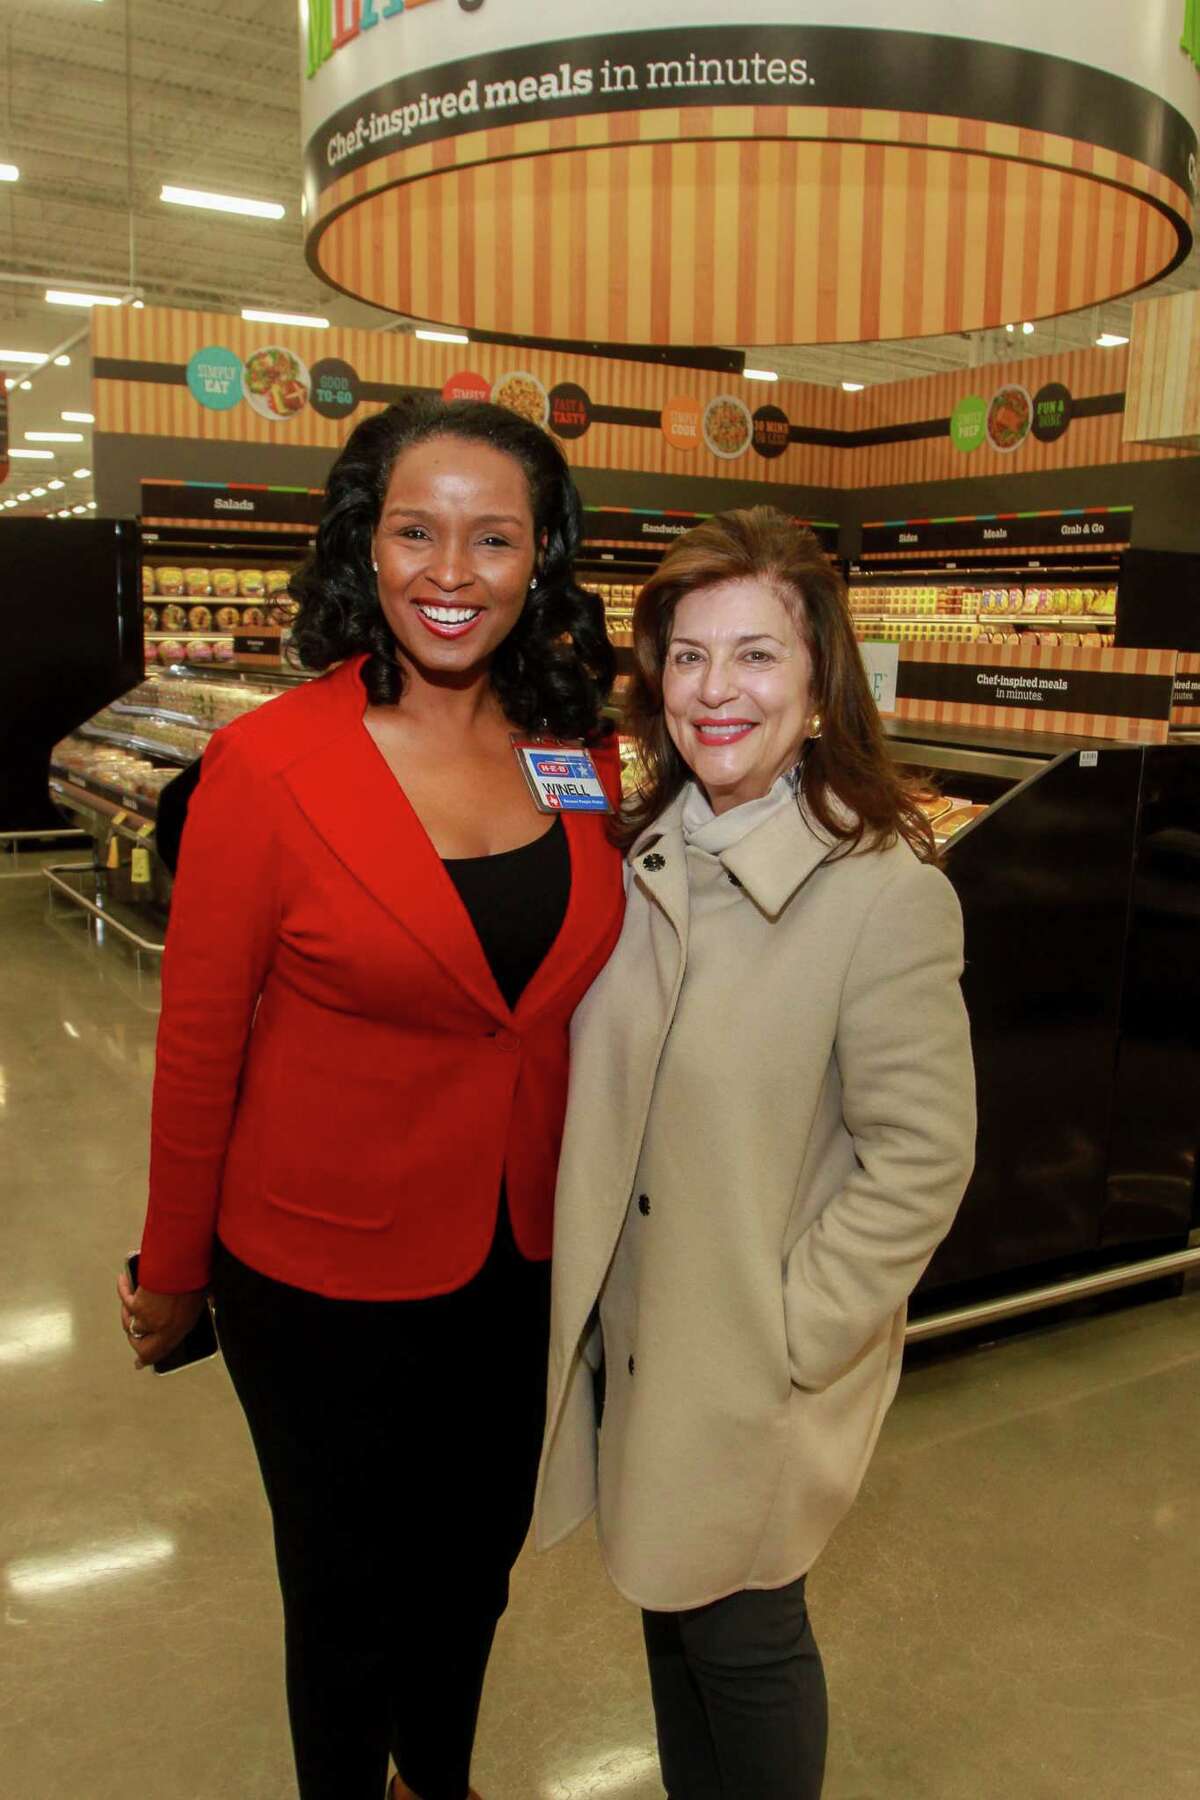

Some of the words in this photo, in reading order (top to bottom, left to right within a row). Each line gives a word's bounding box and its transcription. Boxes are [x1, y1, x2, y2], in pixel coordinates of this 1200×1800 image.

[326, 79, 480, 167] Chef-inspired
[484, 63, 594, 109] meals
[600, 60, 637, 92] in
[646, 53, 816, 90] minutes.
[198, 364, 237, 380] SIMPLY
[204, 379, 231, 394] EAT
[319, 375, 349, 390] GOOD
[317, 388, 353, 404] TO-GO
[452, 387, 486, 400] SIMPLY
[554, 397, 577, 412] FAST
[1037, 400, 1057, 415] FUN
[552, 410, 587, 424] TASTY
[671, 424, 696, 437] COOK
[959, 425, 980, 439] PREP
[213, 498, 254, 511] Salads
[983, 528, 1008, 539] Meals
[1061, 524, 1082, 535] Grab
[1083, 523, 1090, 534] &
[1091, 523, 1104, 534] Go
[899, 533, 918, 543] Sides
[976, 673, 1038, 689] Chef-inspired
[1039, 678, 1068, 690] meals
[996, 687, 1005, 698] in
[542, 783, 591, 797] WINELL
